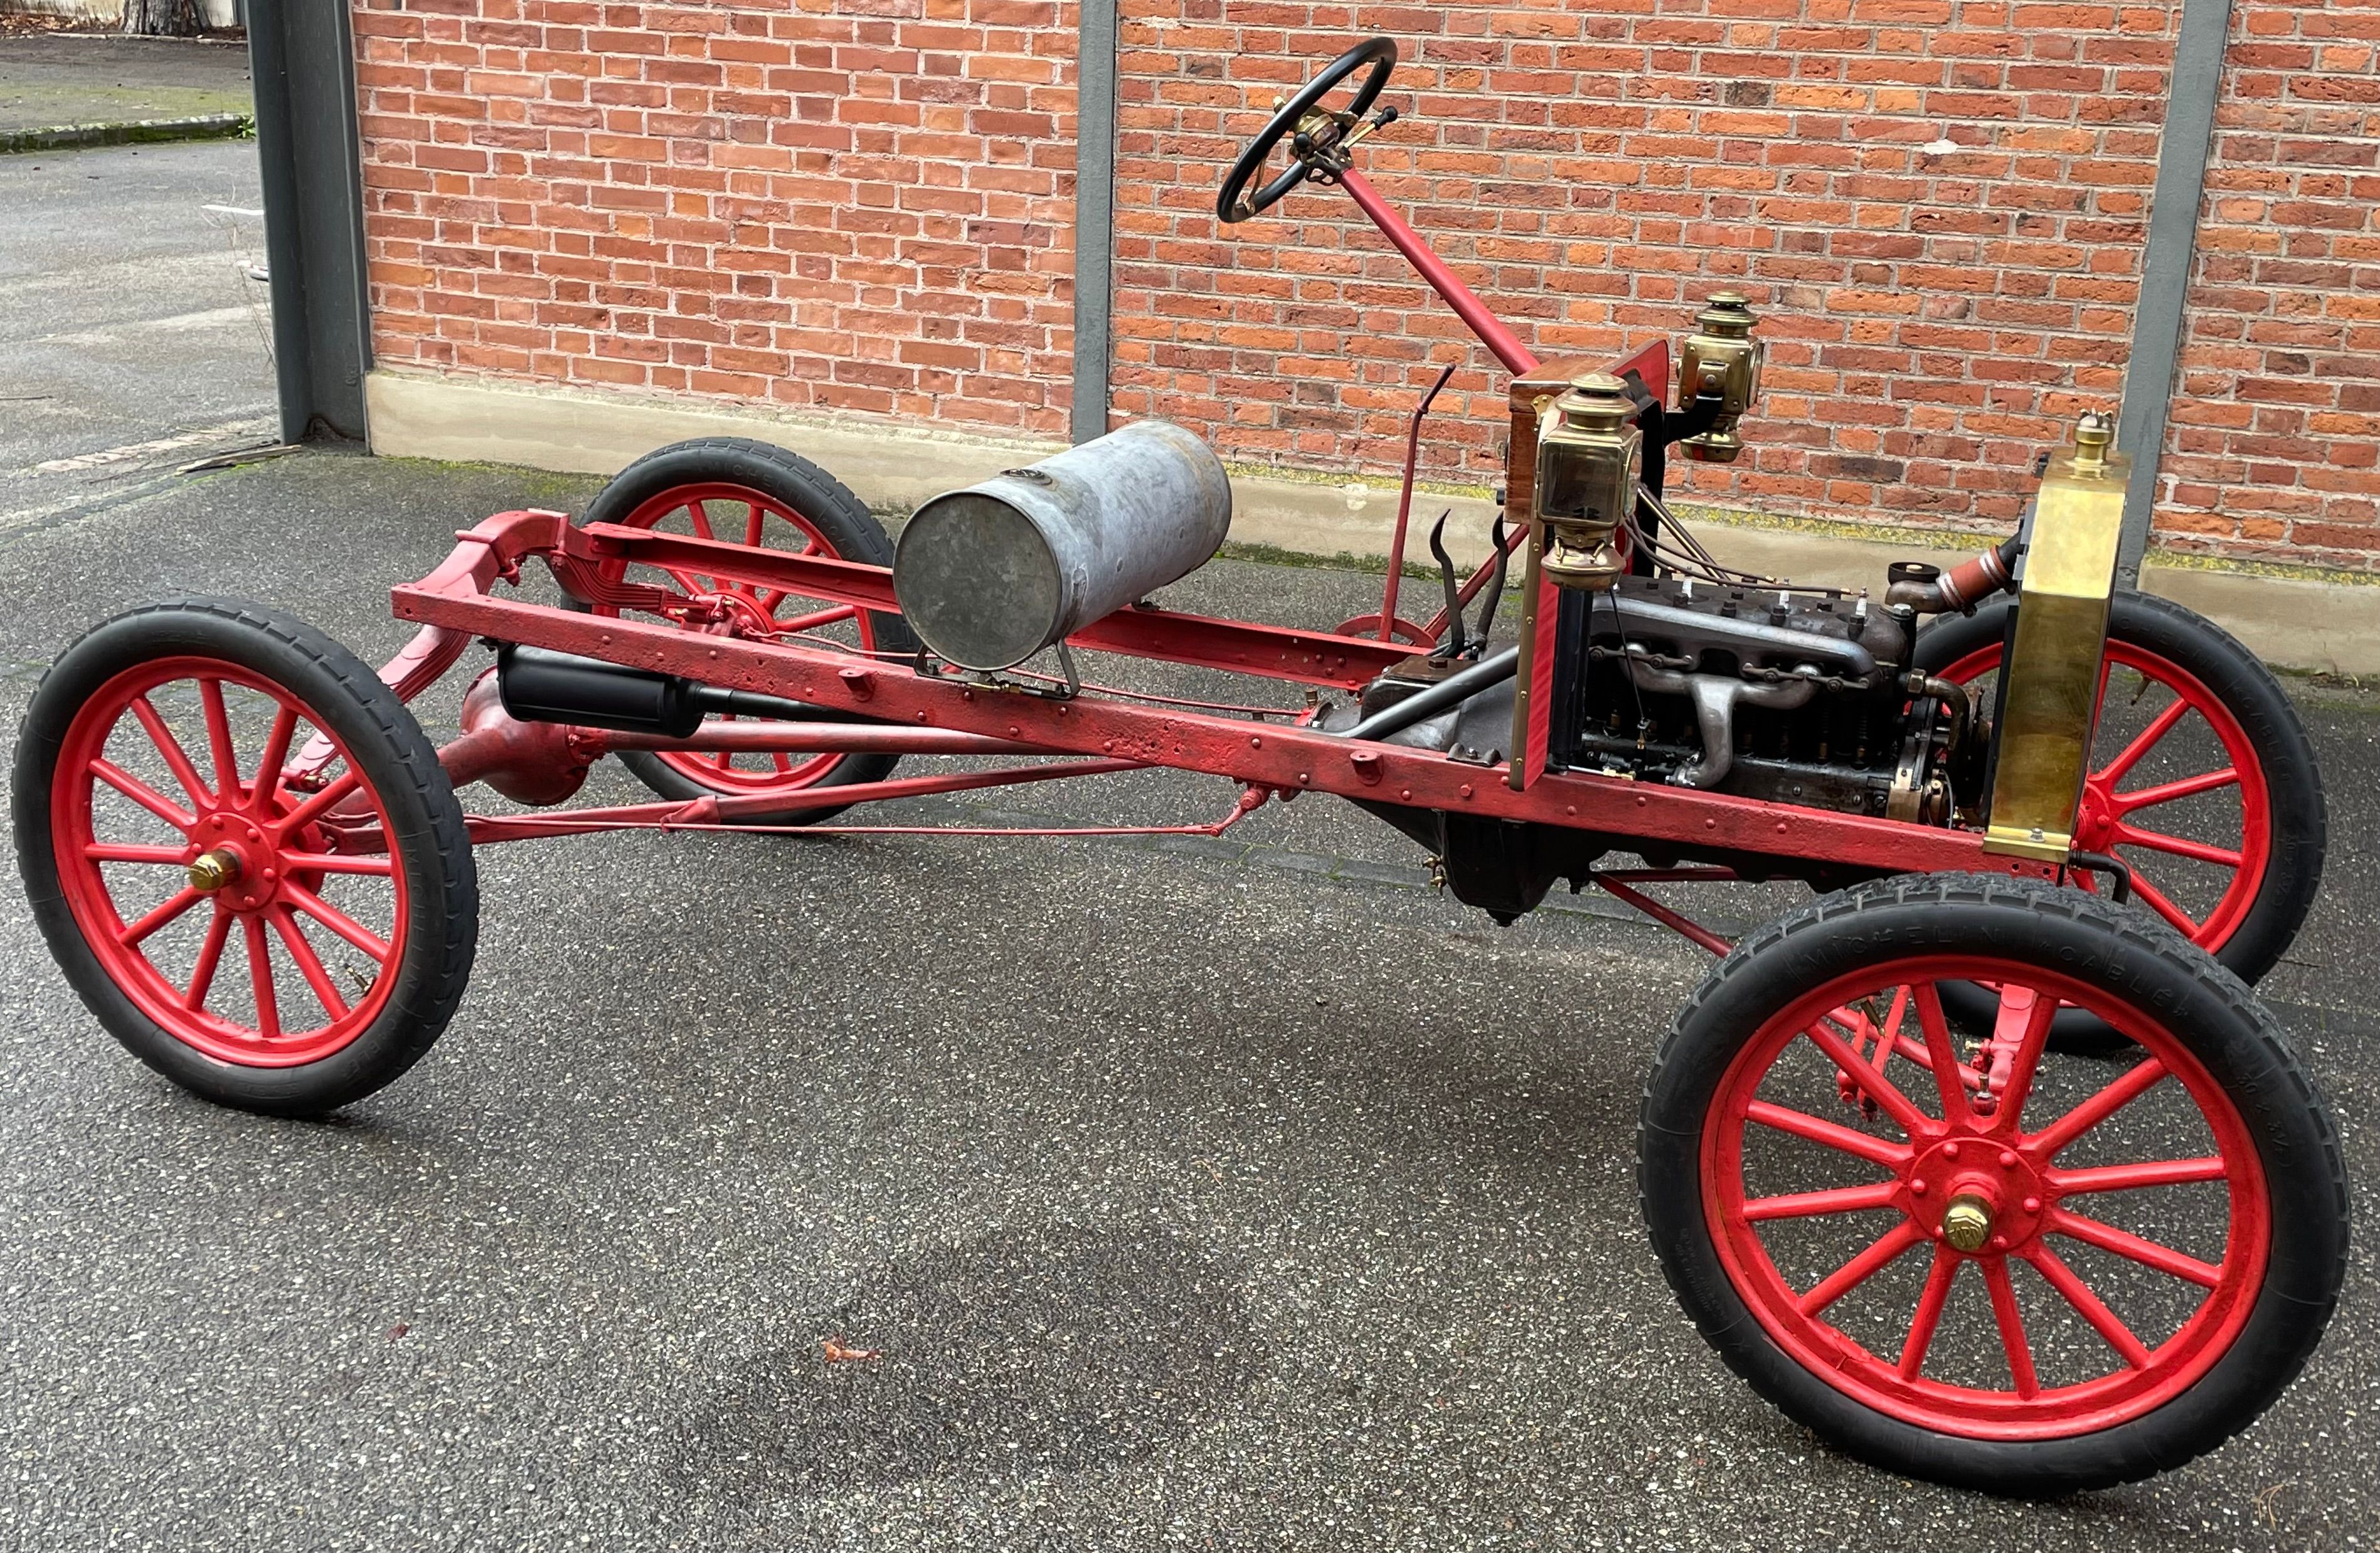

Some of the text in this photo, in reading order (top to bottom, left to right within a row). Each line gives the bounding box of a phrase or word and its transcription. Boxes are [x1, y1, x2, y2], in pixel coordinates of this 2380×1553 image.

[707, 462, 810, 507] MICHELIN
[2118, 616, 2220, 673] CHELIN
[405, 849, 425, 990] MICHELIN
[1797, 925, 2006, 968] MICHELIN
